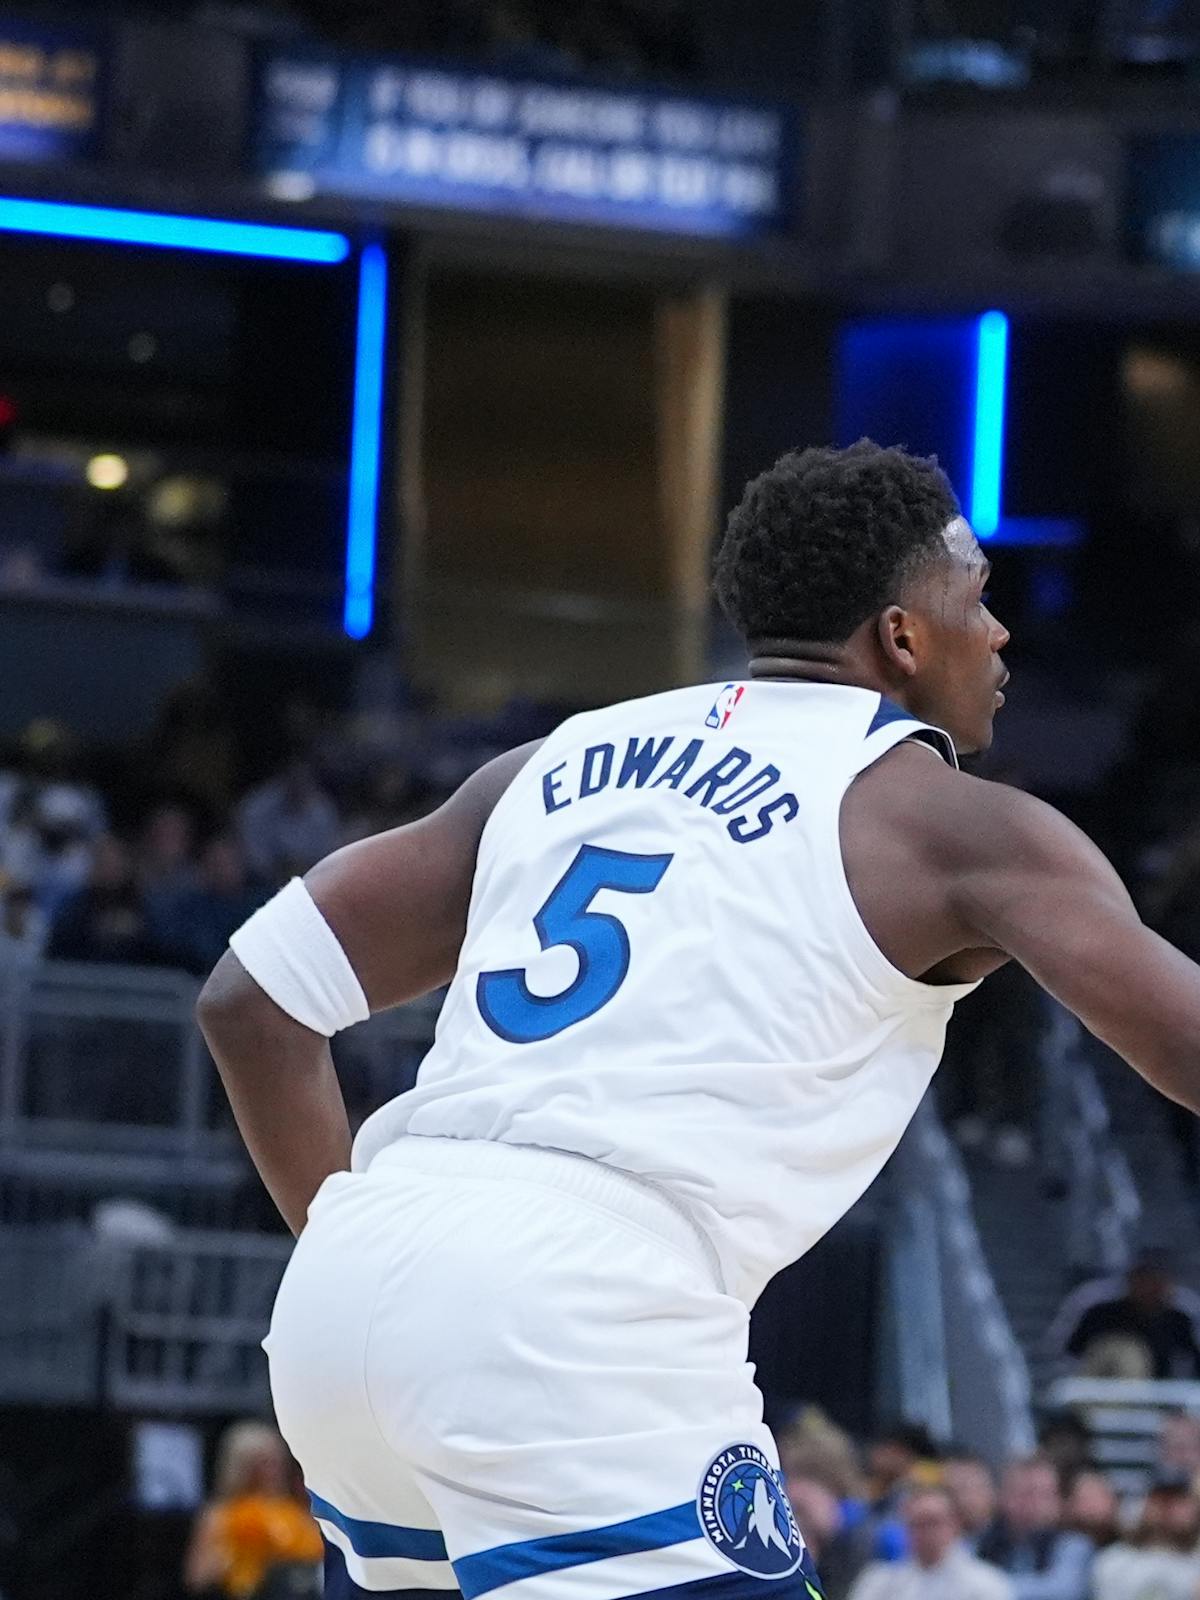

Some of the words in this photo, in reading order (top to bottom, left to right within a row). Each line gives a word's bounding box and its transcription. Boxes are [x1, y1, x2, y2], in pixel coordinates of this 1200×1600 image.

[542, 736, 800, 844] EDWARDS
[476, 843, 674, 1044] 5
[701, 1451, 736, 1544] MINNESOTA
